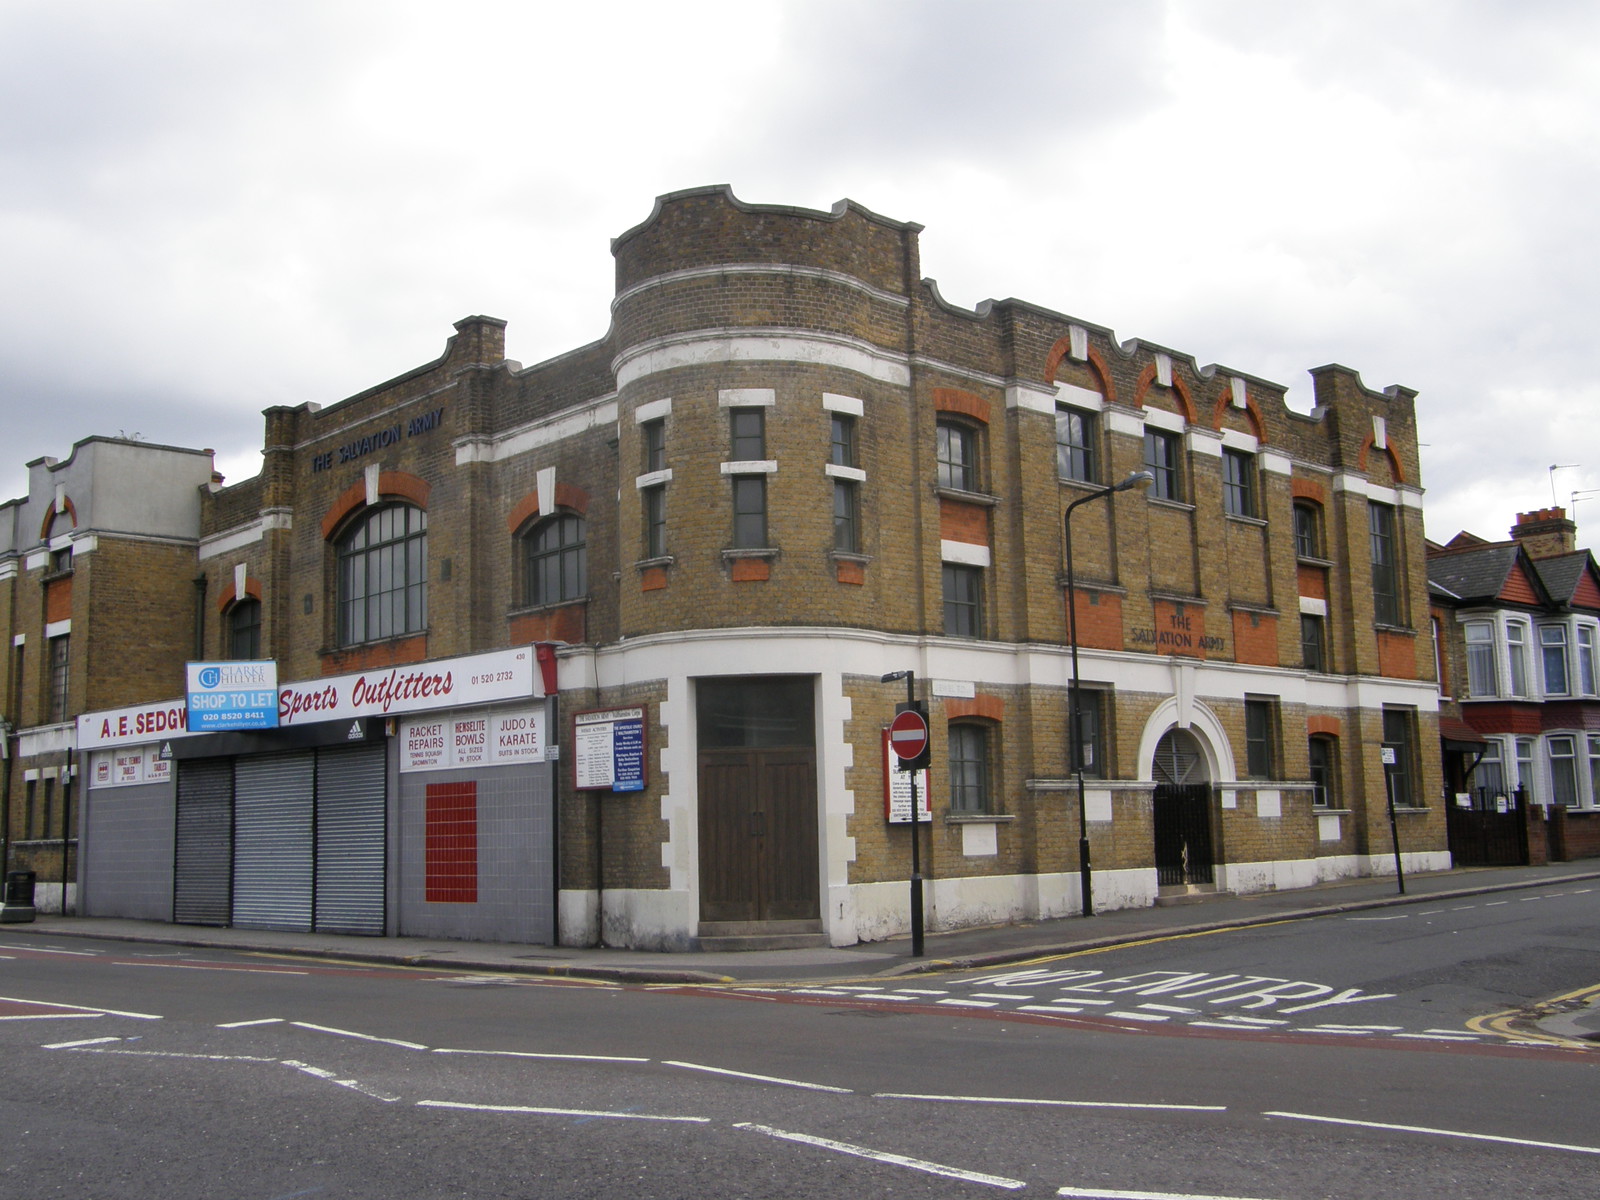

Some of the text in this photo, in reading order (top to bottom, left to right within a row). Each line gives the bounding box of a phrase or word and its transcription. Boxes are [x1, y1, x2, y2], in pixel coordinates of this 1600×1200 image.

[313, 407, 443, 473] THE SALVATION ARMY
[1171, 615, 1191, 631] THE
[1131, 627, 1225, 651] SALVATION ARMY
[221, 666, 265, 676] CLARKE
[471, 671, 513, 685] 01 520 2732
[221, 675, 265, 684] HILLYER
[192, 692, 274, 709] SHOP TO LET
[279, 684, 339, 724] Sports
[352, 669, 454, 713] Outfitters
[203, 711, 264, 721] 020 8520 8411
[409, 724, 443, 738] RACKET
[500, 717, 536, 731] JUDO &
[408, 737, 444, 750] REPAIRS
[455, 732, 485, 746] BOWLS
[499, 732, 537, 746] KARATE
[409, 750, 442, 759] TENNIS SQUASH
[469, 746, 483, 754] SIZES
[498, 749, 513, 757] SUITS
[520, 747, 538, 755] STOCK
[946, 968, 1397, 1014] NO ENTRY
